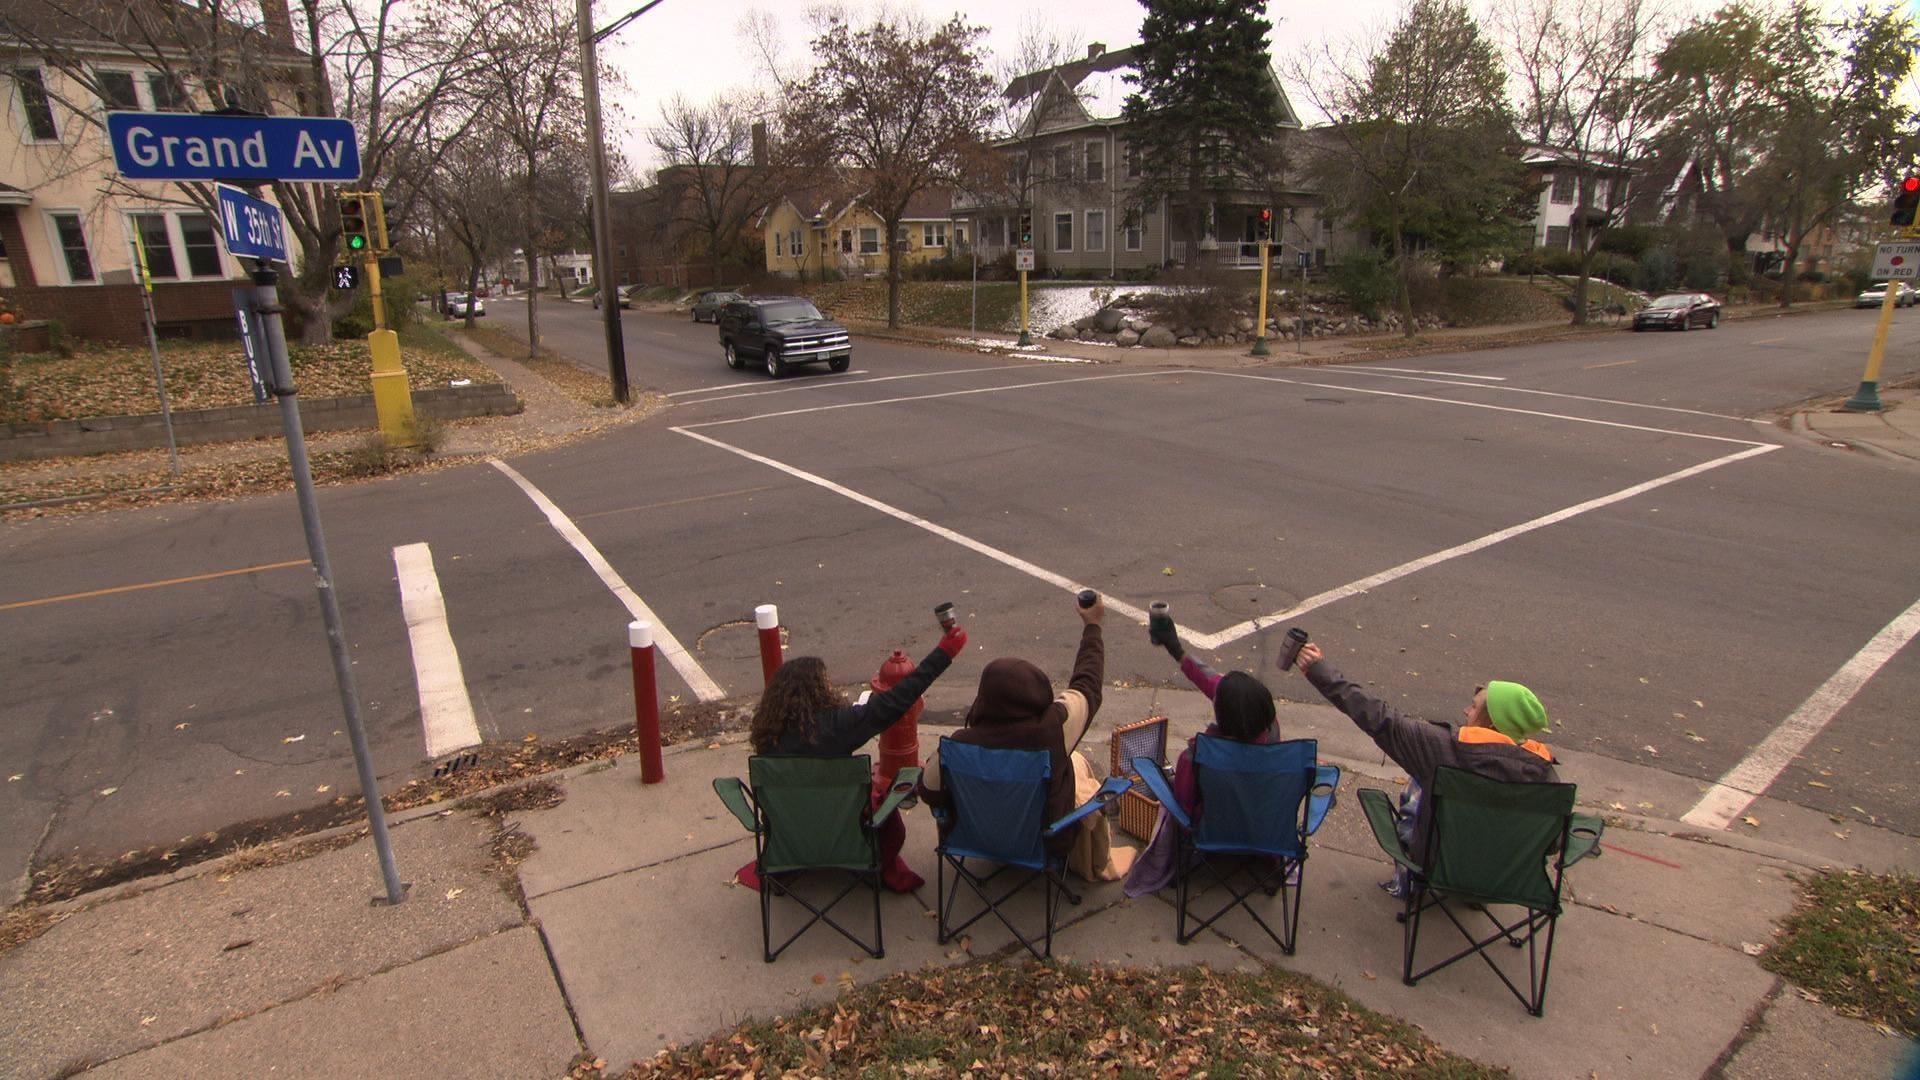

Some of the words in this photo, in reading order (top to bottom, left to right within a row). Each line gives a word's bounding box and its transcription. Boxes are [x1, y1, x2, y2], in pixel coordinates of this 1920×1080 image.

[127, 126, 268, 168] Grand
[293, 130, 344, 168] Av
[223, 199, 239, 241] W
[244, 206, 272, 247] 35th
[271, 215, 282, 249] St
[1896, 246, 1920, 254] TURN
[1894, 268, 1913, 276] RED
